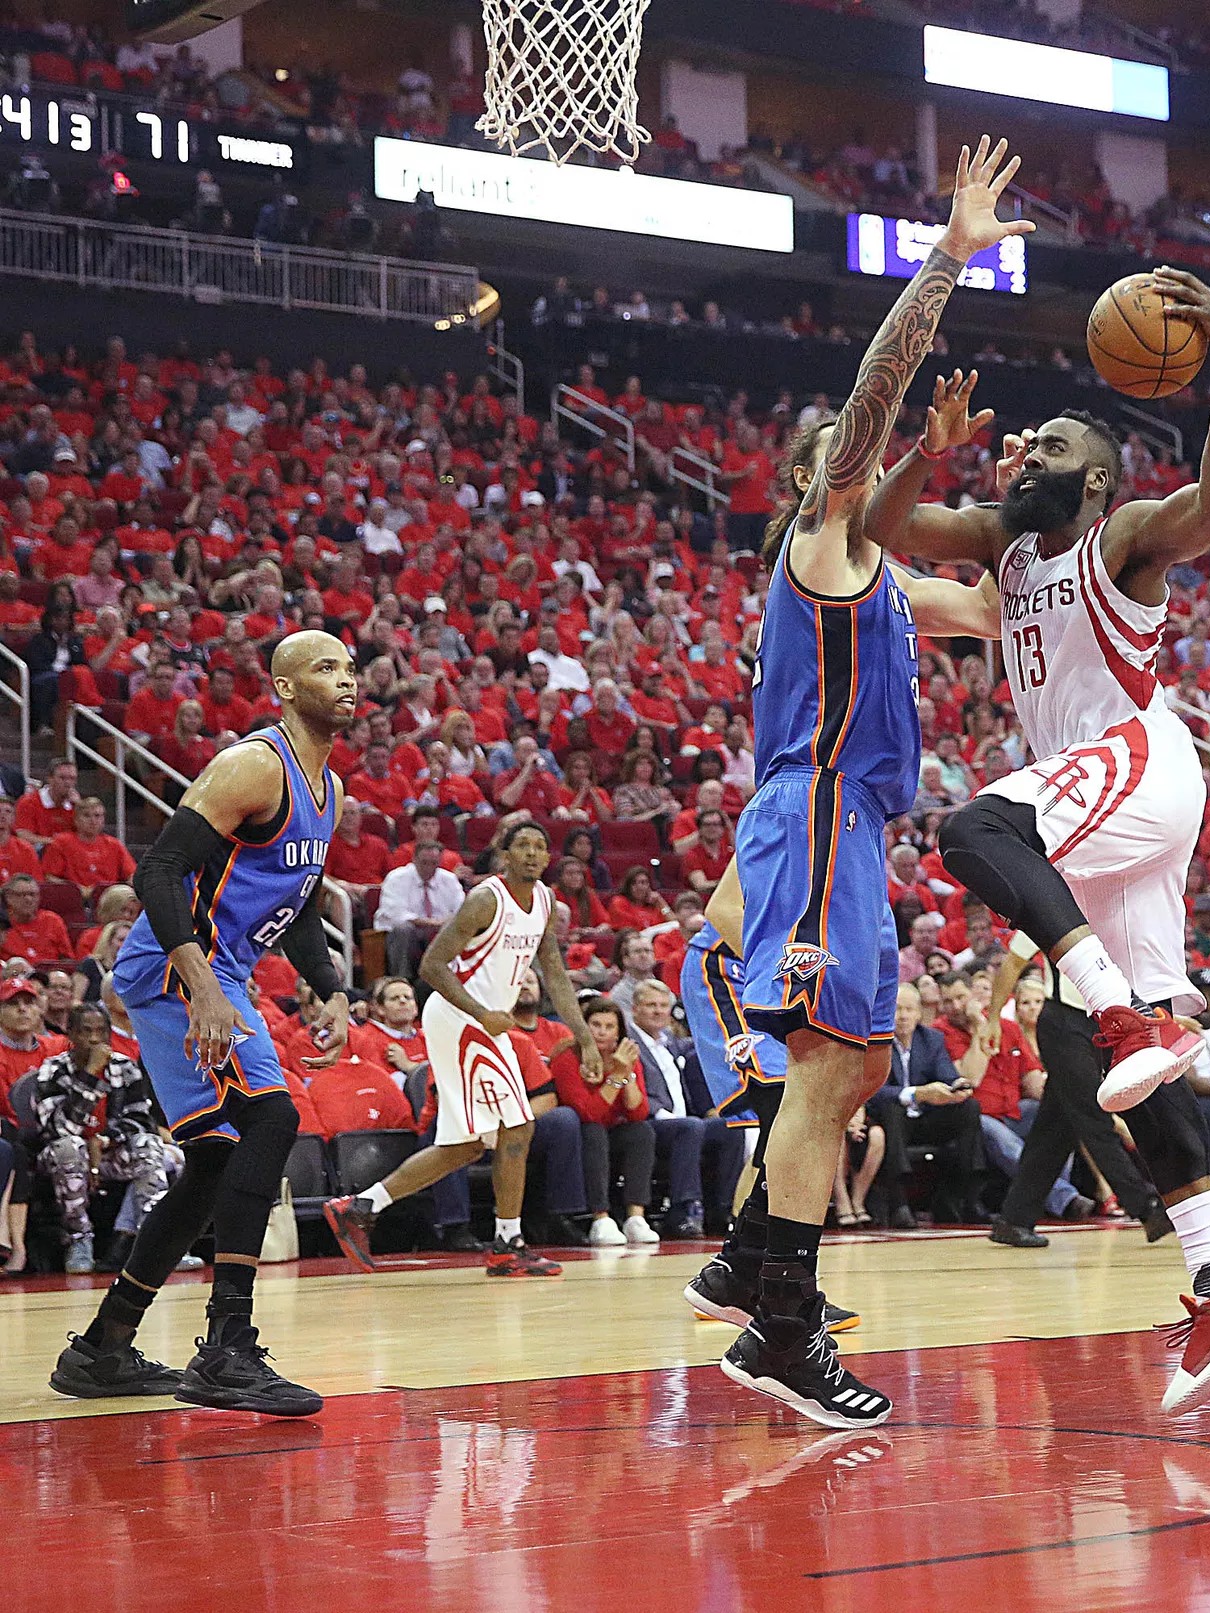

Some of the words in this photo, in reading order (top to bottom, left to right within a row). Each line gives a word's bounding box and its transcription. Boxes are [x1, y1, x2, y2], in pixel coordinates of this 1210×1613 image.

[136, 112, 188, 162] 71
[1012, 624, 1048, 693] 13
[503, 934, 541, 950] ROCKET
[784, 951, 820, 970] OKC
